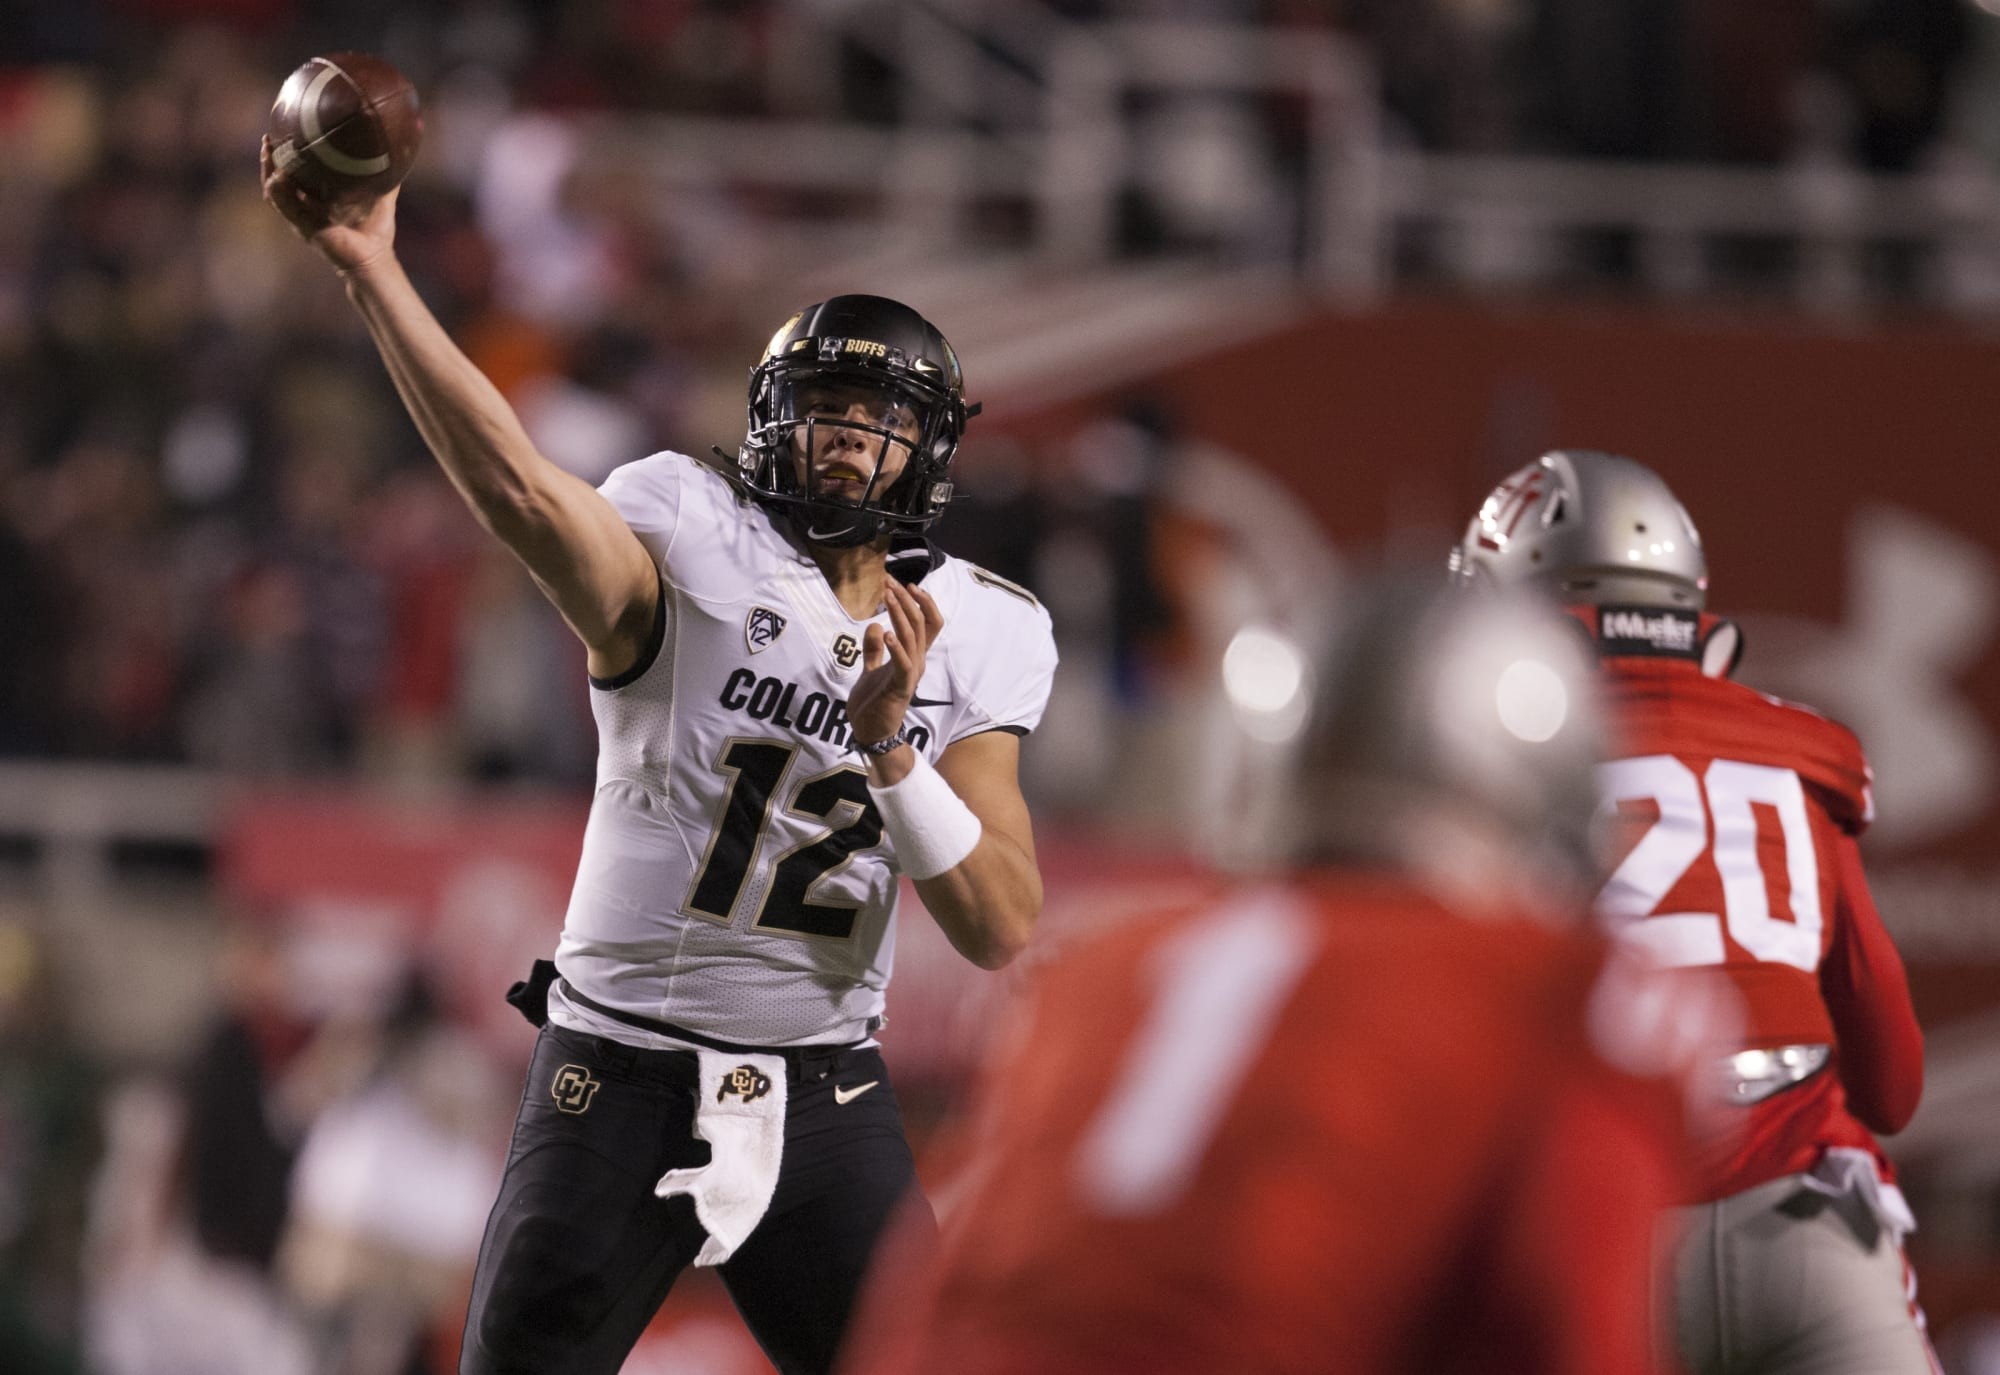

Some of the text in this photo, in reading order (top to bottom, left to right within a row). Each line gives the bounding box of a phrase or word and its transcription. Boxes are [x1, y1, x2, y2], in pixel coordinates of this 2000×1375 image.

[845, 339, 886, 357] BUFFS
[749, 607, 787, 642] PAC
[750, 626, 772, 646] 12
[832, 633, 862, 668] CU
[719, 667, 931, 757] COLORO
[677, 736, 884, 942] 12
[1594, 754, 1823, 973] 20
[551, 1063, 600, 1114] CU
